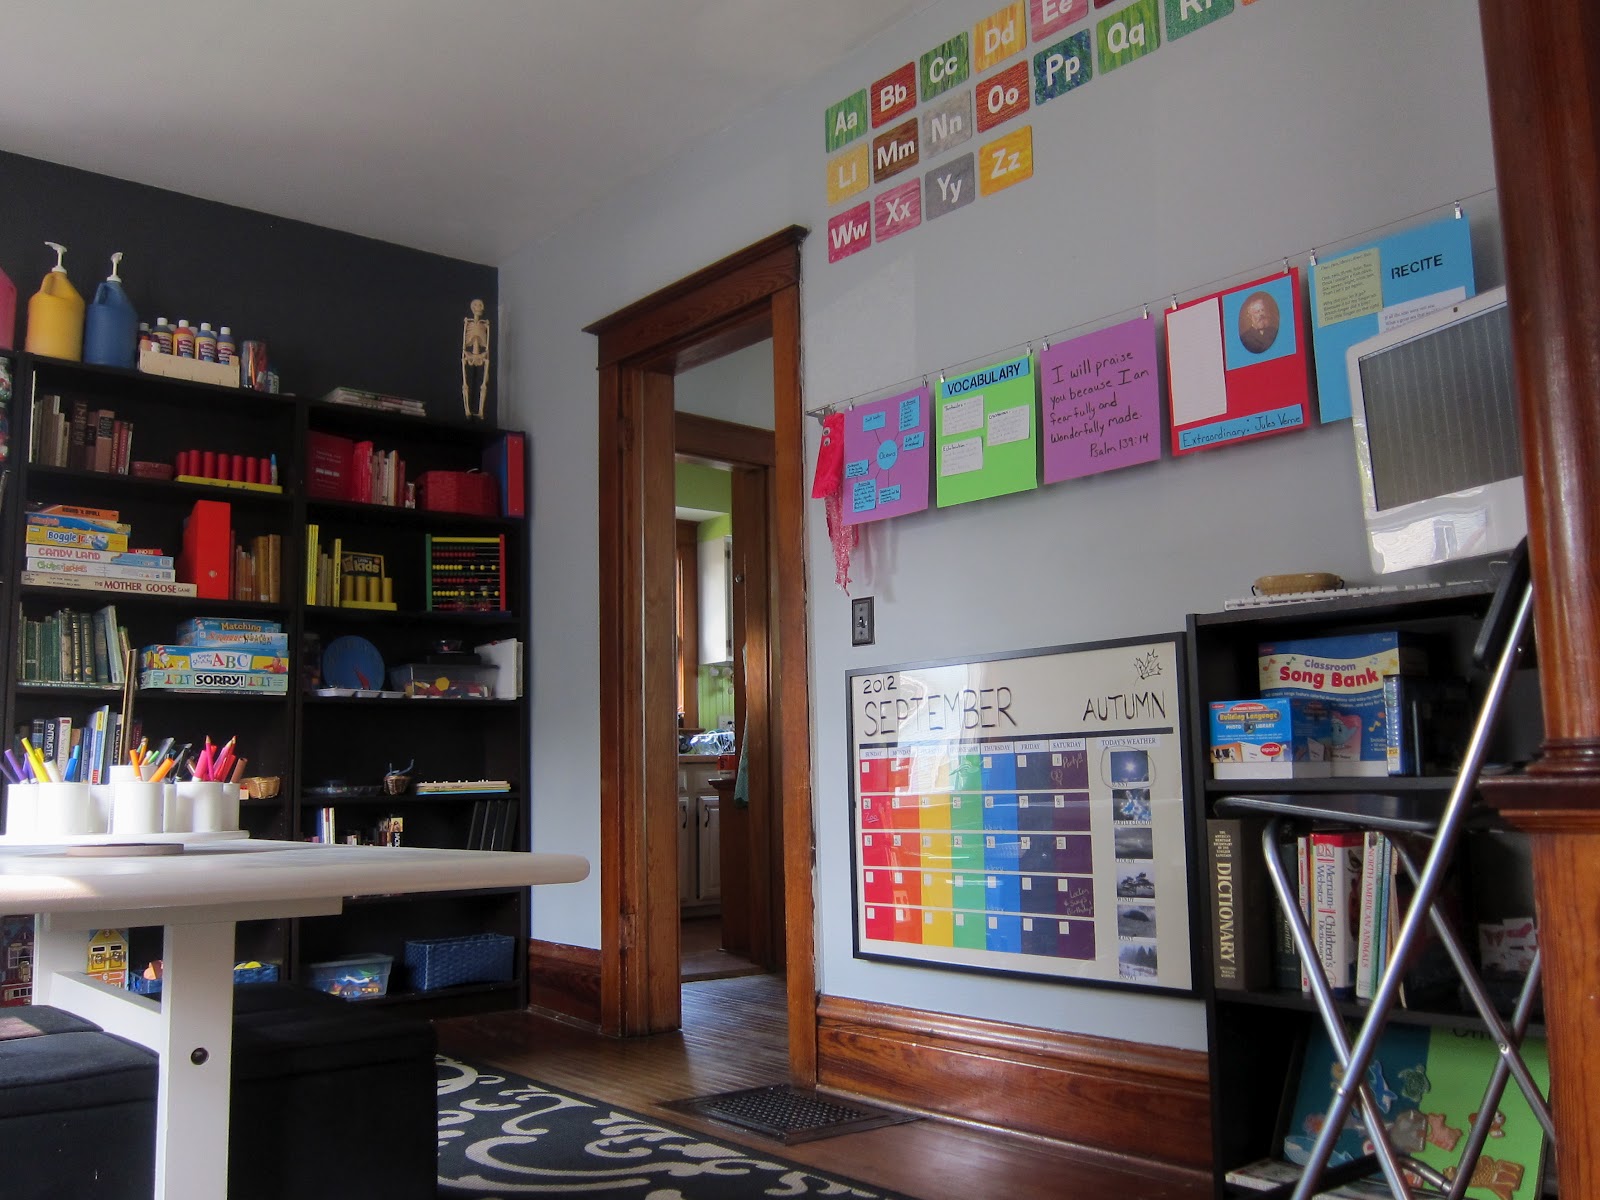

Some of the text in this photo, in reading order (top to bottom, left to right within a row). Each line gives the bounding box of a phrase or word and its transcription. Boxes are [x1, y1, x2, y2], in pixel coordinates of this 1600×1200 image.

[985, 20, 1014, 55] Dd
[1107, 22, 1146, 53] Qq
[930, 56, 958, 83] Cc
[1046, 54, 1080, 86] Pp
[880, 84, 907, 112] Bb
[988, 85, 1019, 113] Oo
[835, 112, 857, 136] Aa
[931, 111, 962, 144] Nn
[877, 140, 915, 170] Mm
[991, 148, 1021, 179] Zz
[838, 162, 857, 189] Ll
[937, 173, 962, 203] Yy
[885, 198, 911, 226] Xx
[831, 220, 867, 249] Ww
[1391, 253, 1443, 279] RECITE
[947, 362, 1021, 395] VOCABULARY
[1052, 352, 1134, 384] I will praise
[1050, 368, 1150, 410] you because I am
[1050, 391, 1118, 426] fearfully and
[1255, 416, 1276, 430] Jules
[1278, 412, 1301, 426] Verne
[1090, 433, 1149, 458] Psalm 139:14
[47, 530, 77, 543] Boggle
[38, 547, 101, 560] CANDY LAND
[354, 561, 380, 573] kids
[104, 580, 142, 592] MOTHER
[145, 583, 177, 593] GOOSE
[221, 622, 262, 632] Matching
[1279, 666, 1379, 689] Song Bank
[1304, 659, 1356, 671] Classroom
[195, 674, 245, 687] SORRY!
[863, 675, 897, 694] 2012
[864, 686, 1018, 736] SEPTEMBER
[1082, 690, 1166, 721] AUTUMN
[1219, 712, 1278, 721] Building Language
[46, 723, 55, 757] ENTRUSTE
[983, 744, 1011, 752] THURSDAY
[1052, 741, 1082, 749] SATURDAY
[1127, 737, 1157, 745] WEATHER
[1316, 865, 1326, 904] Webster
[1325, 864, 1335, 909] Merriam-
[1216, 862, 1236, 964] DICTIONARY
[1361, 848, 1375, 968] NORTH AMERICAN ANIMALS
[1324, 915, 1337, 968] Children's
